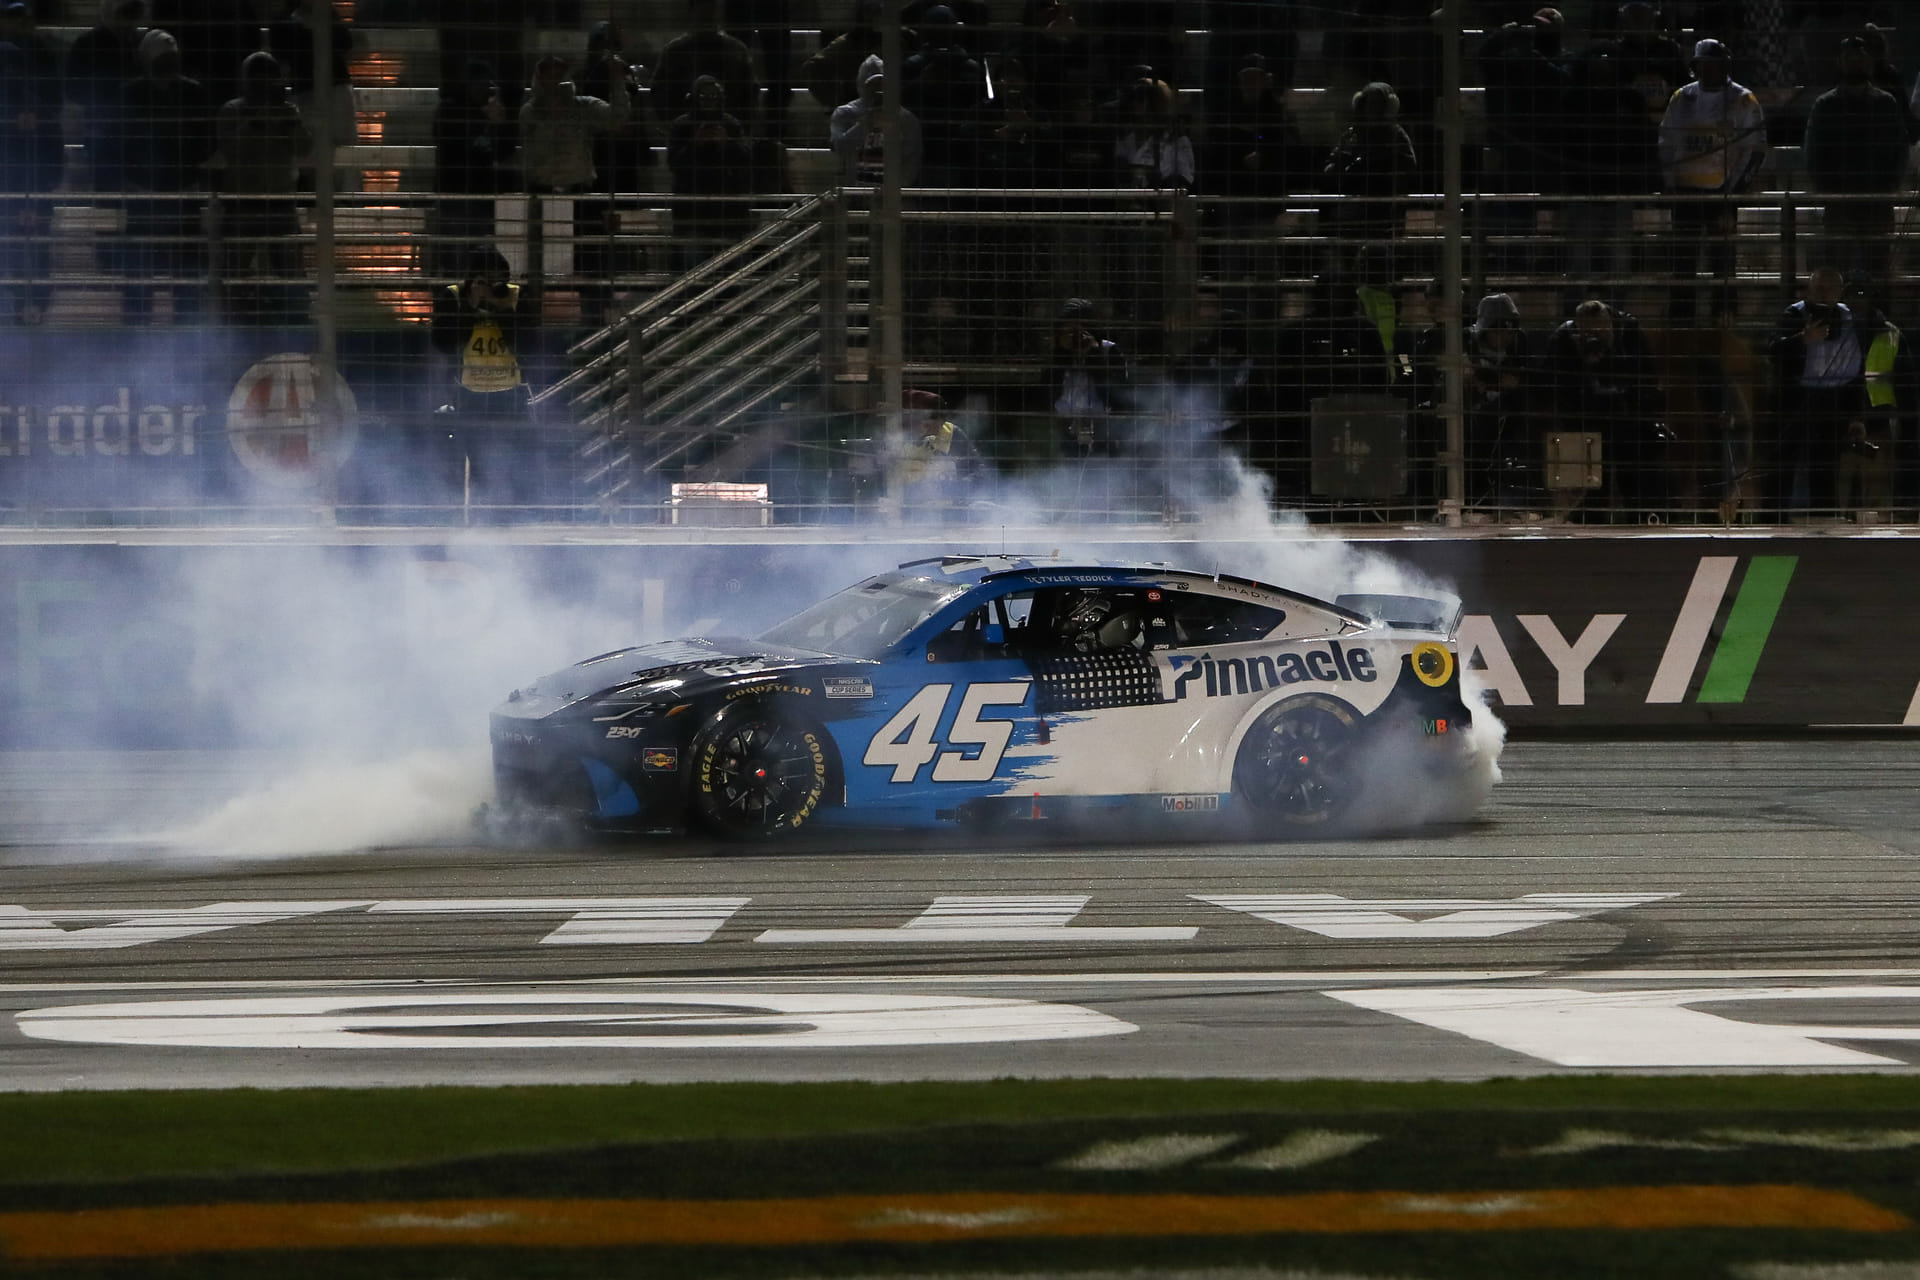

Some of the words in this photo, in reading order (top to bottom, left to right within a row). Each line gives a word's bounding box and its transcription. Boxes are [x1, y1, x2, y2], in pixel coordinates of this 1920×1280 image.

[1071, 575, 1114, 583] REDDICK
[726, 683, 812, 701] GOODYEAR
[1168, 641, 1377, 700] Pinnacle
[863, 682, 1029, 783] 45
[702, 743, 718, 793] EAGLE
[791, 733, 826, 828] GOODYEAR
[1163, 798, 1201, 811] Mobil
